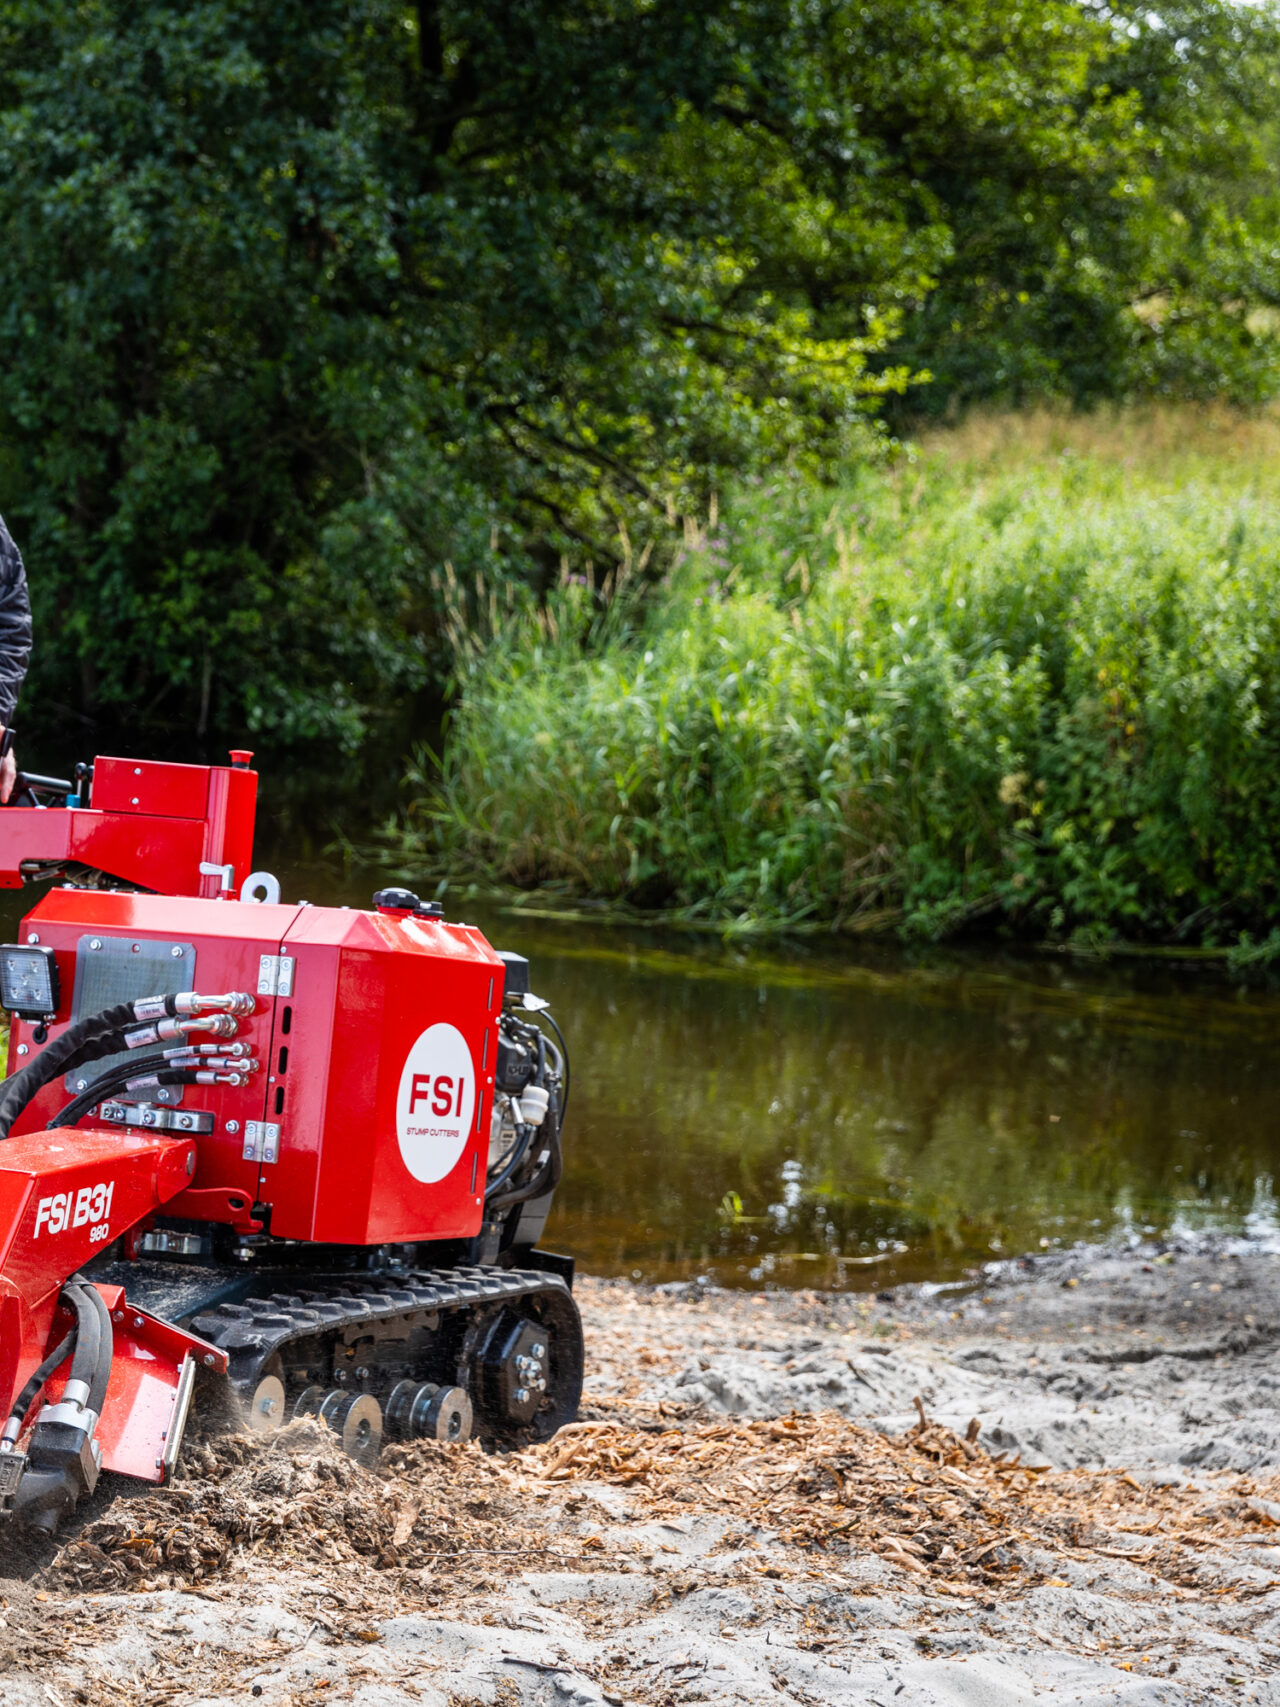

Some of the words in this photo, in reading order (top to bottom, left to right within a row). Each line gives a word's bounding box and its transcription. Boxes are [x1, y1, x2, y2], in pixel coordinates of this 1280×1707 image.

[408, 1073, 464, 1117] FSI
[407, 1127, 429, 1136] STUMP
[430, 1128, 459, 1138] CUTTERS
[33, 1191, 74, 1239] FSI
[72, 1181, 115, 1228] B31
[89, 1223, 109, 1243] 980
